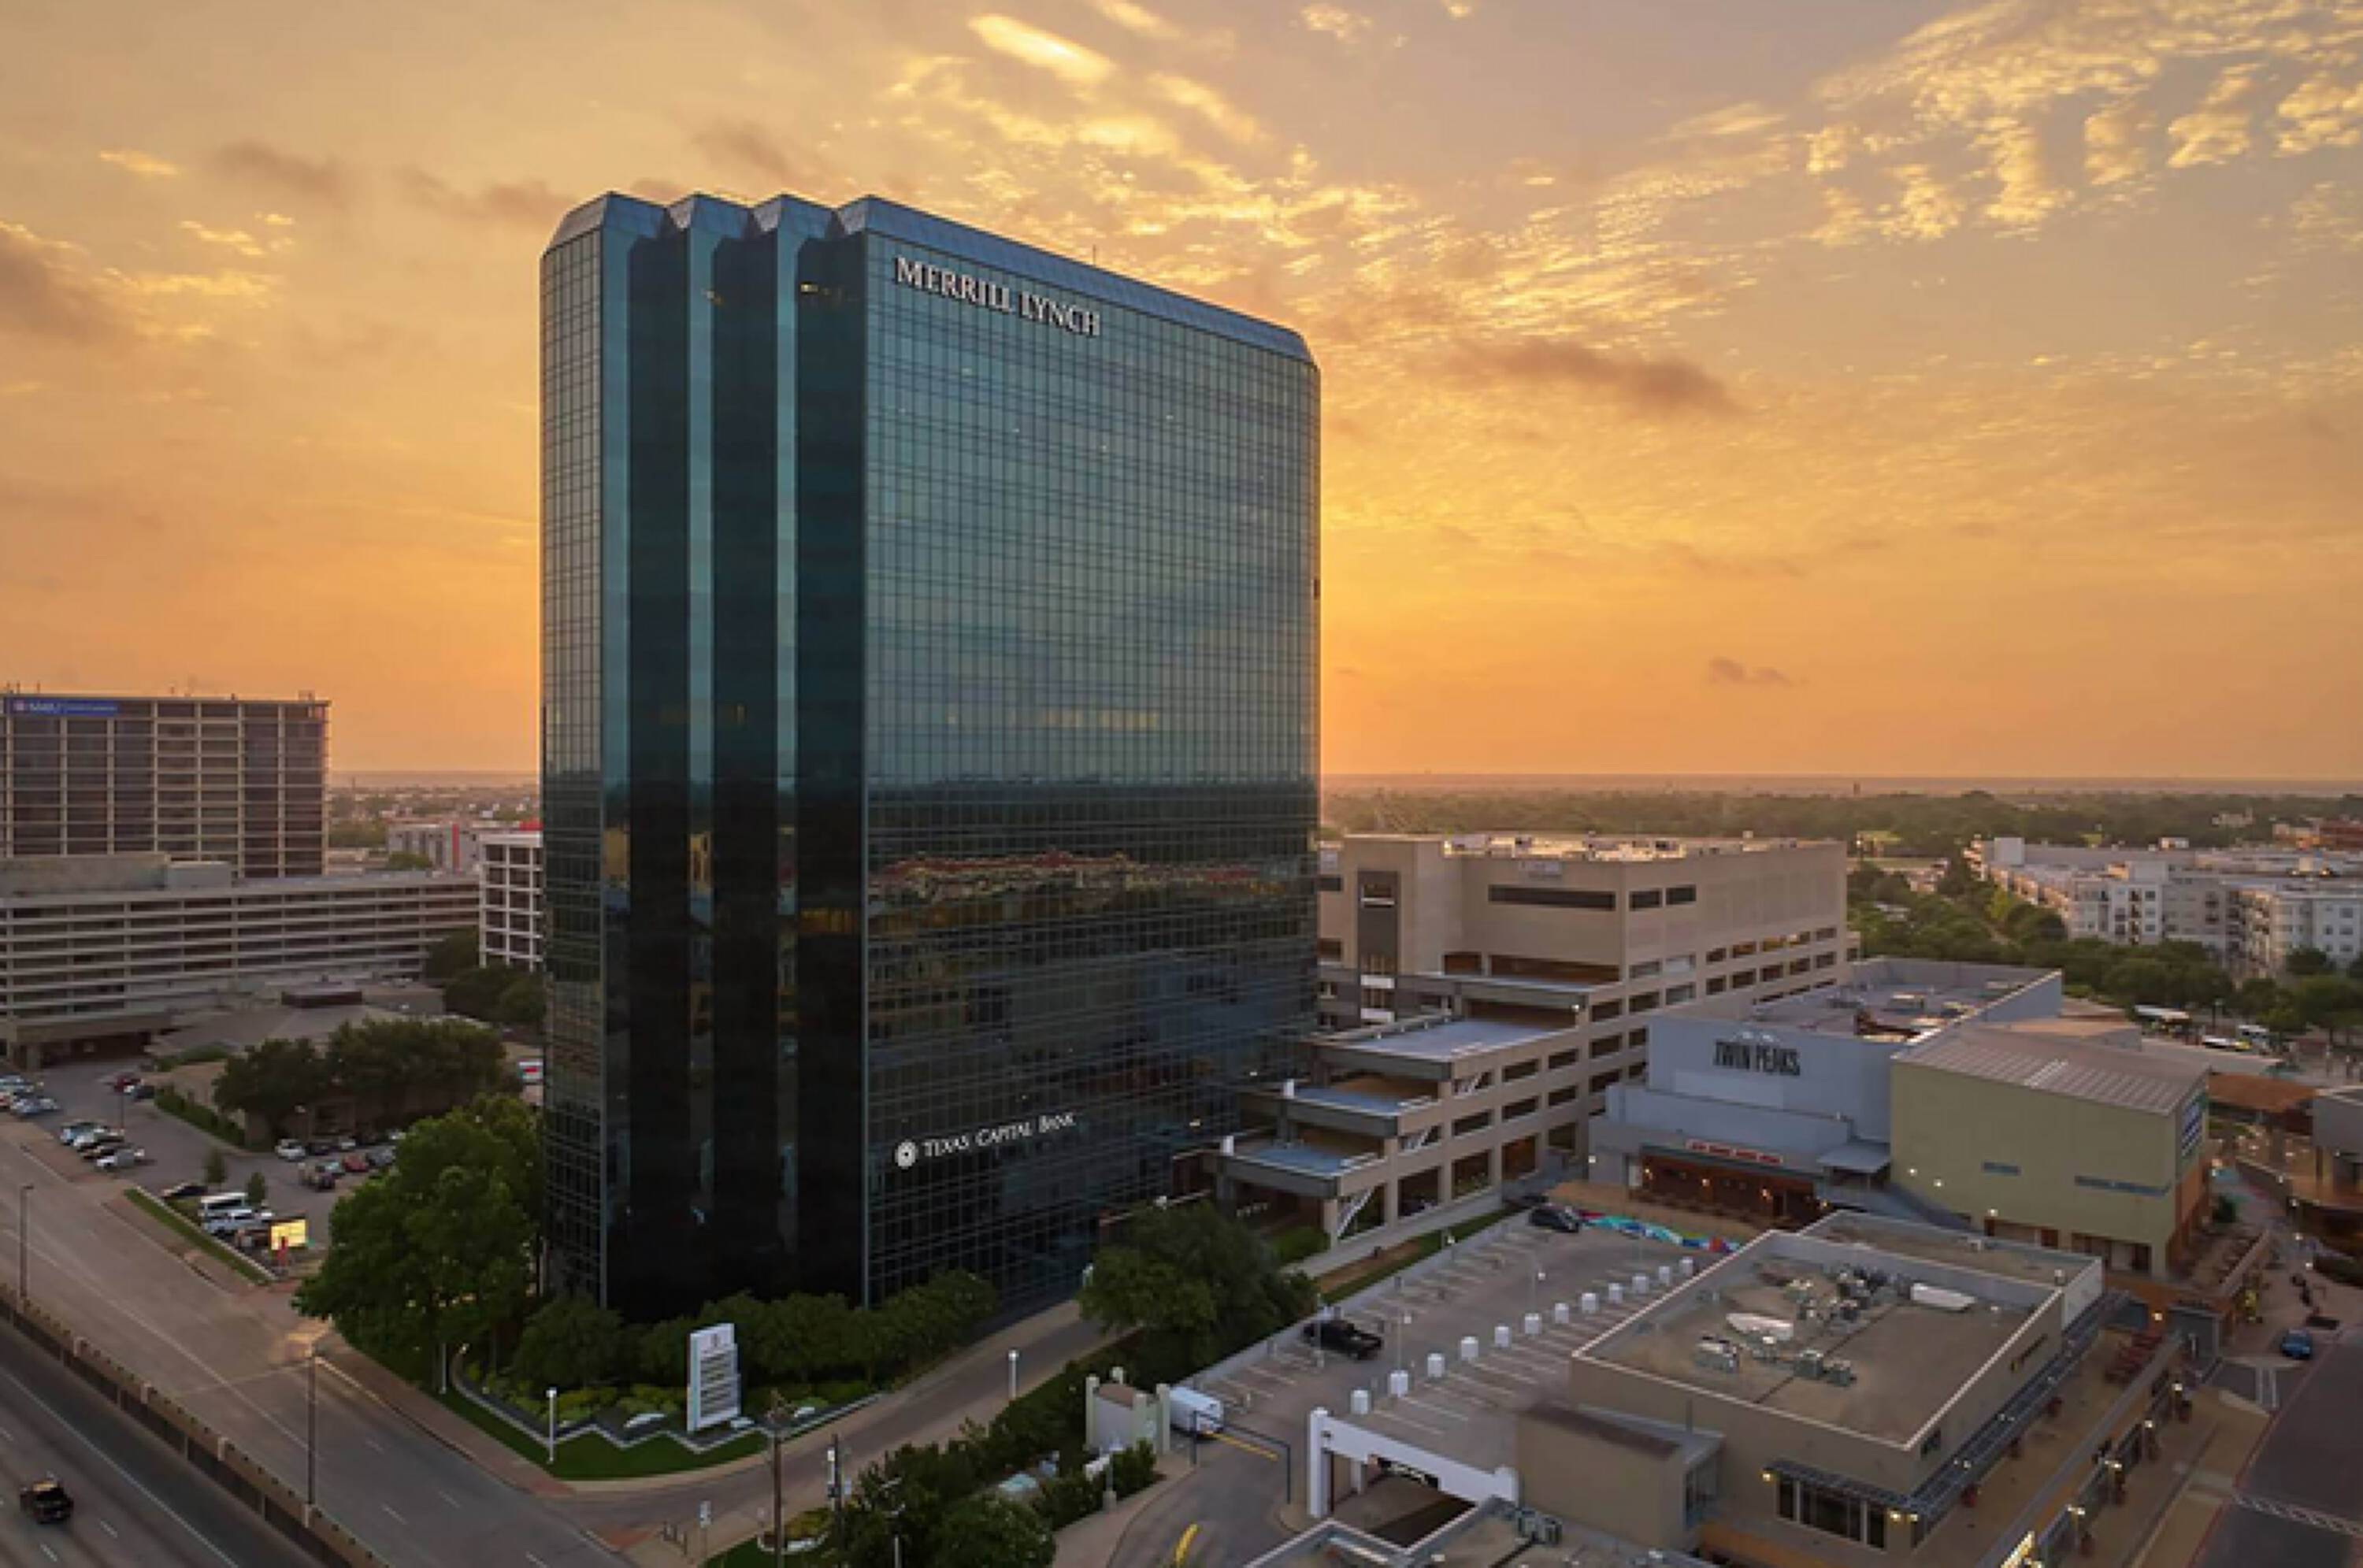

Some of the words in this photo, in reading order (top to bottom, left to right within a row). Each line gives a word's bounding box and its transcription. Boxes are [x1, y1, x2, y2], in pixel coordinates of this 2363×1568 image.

[895, 255, 1012, 313] MERRILL
[1018, 291, 1101, 336] LYNCH
[1713, 1040, 1750, 1069] TWIN
[1755, 1044, 1801, 1076] PEAKS
